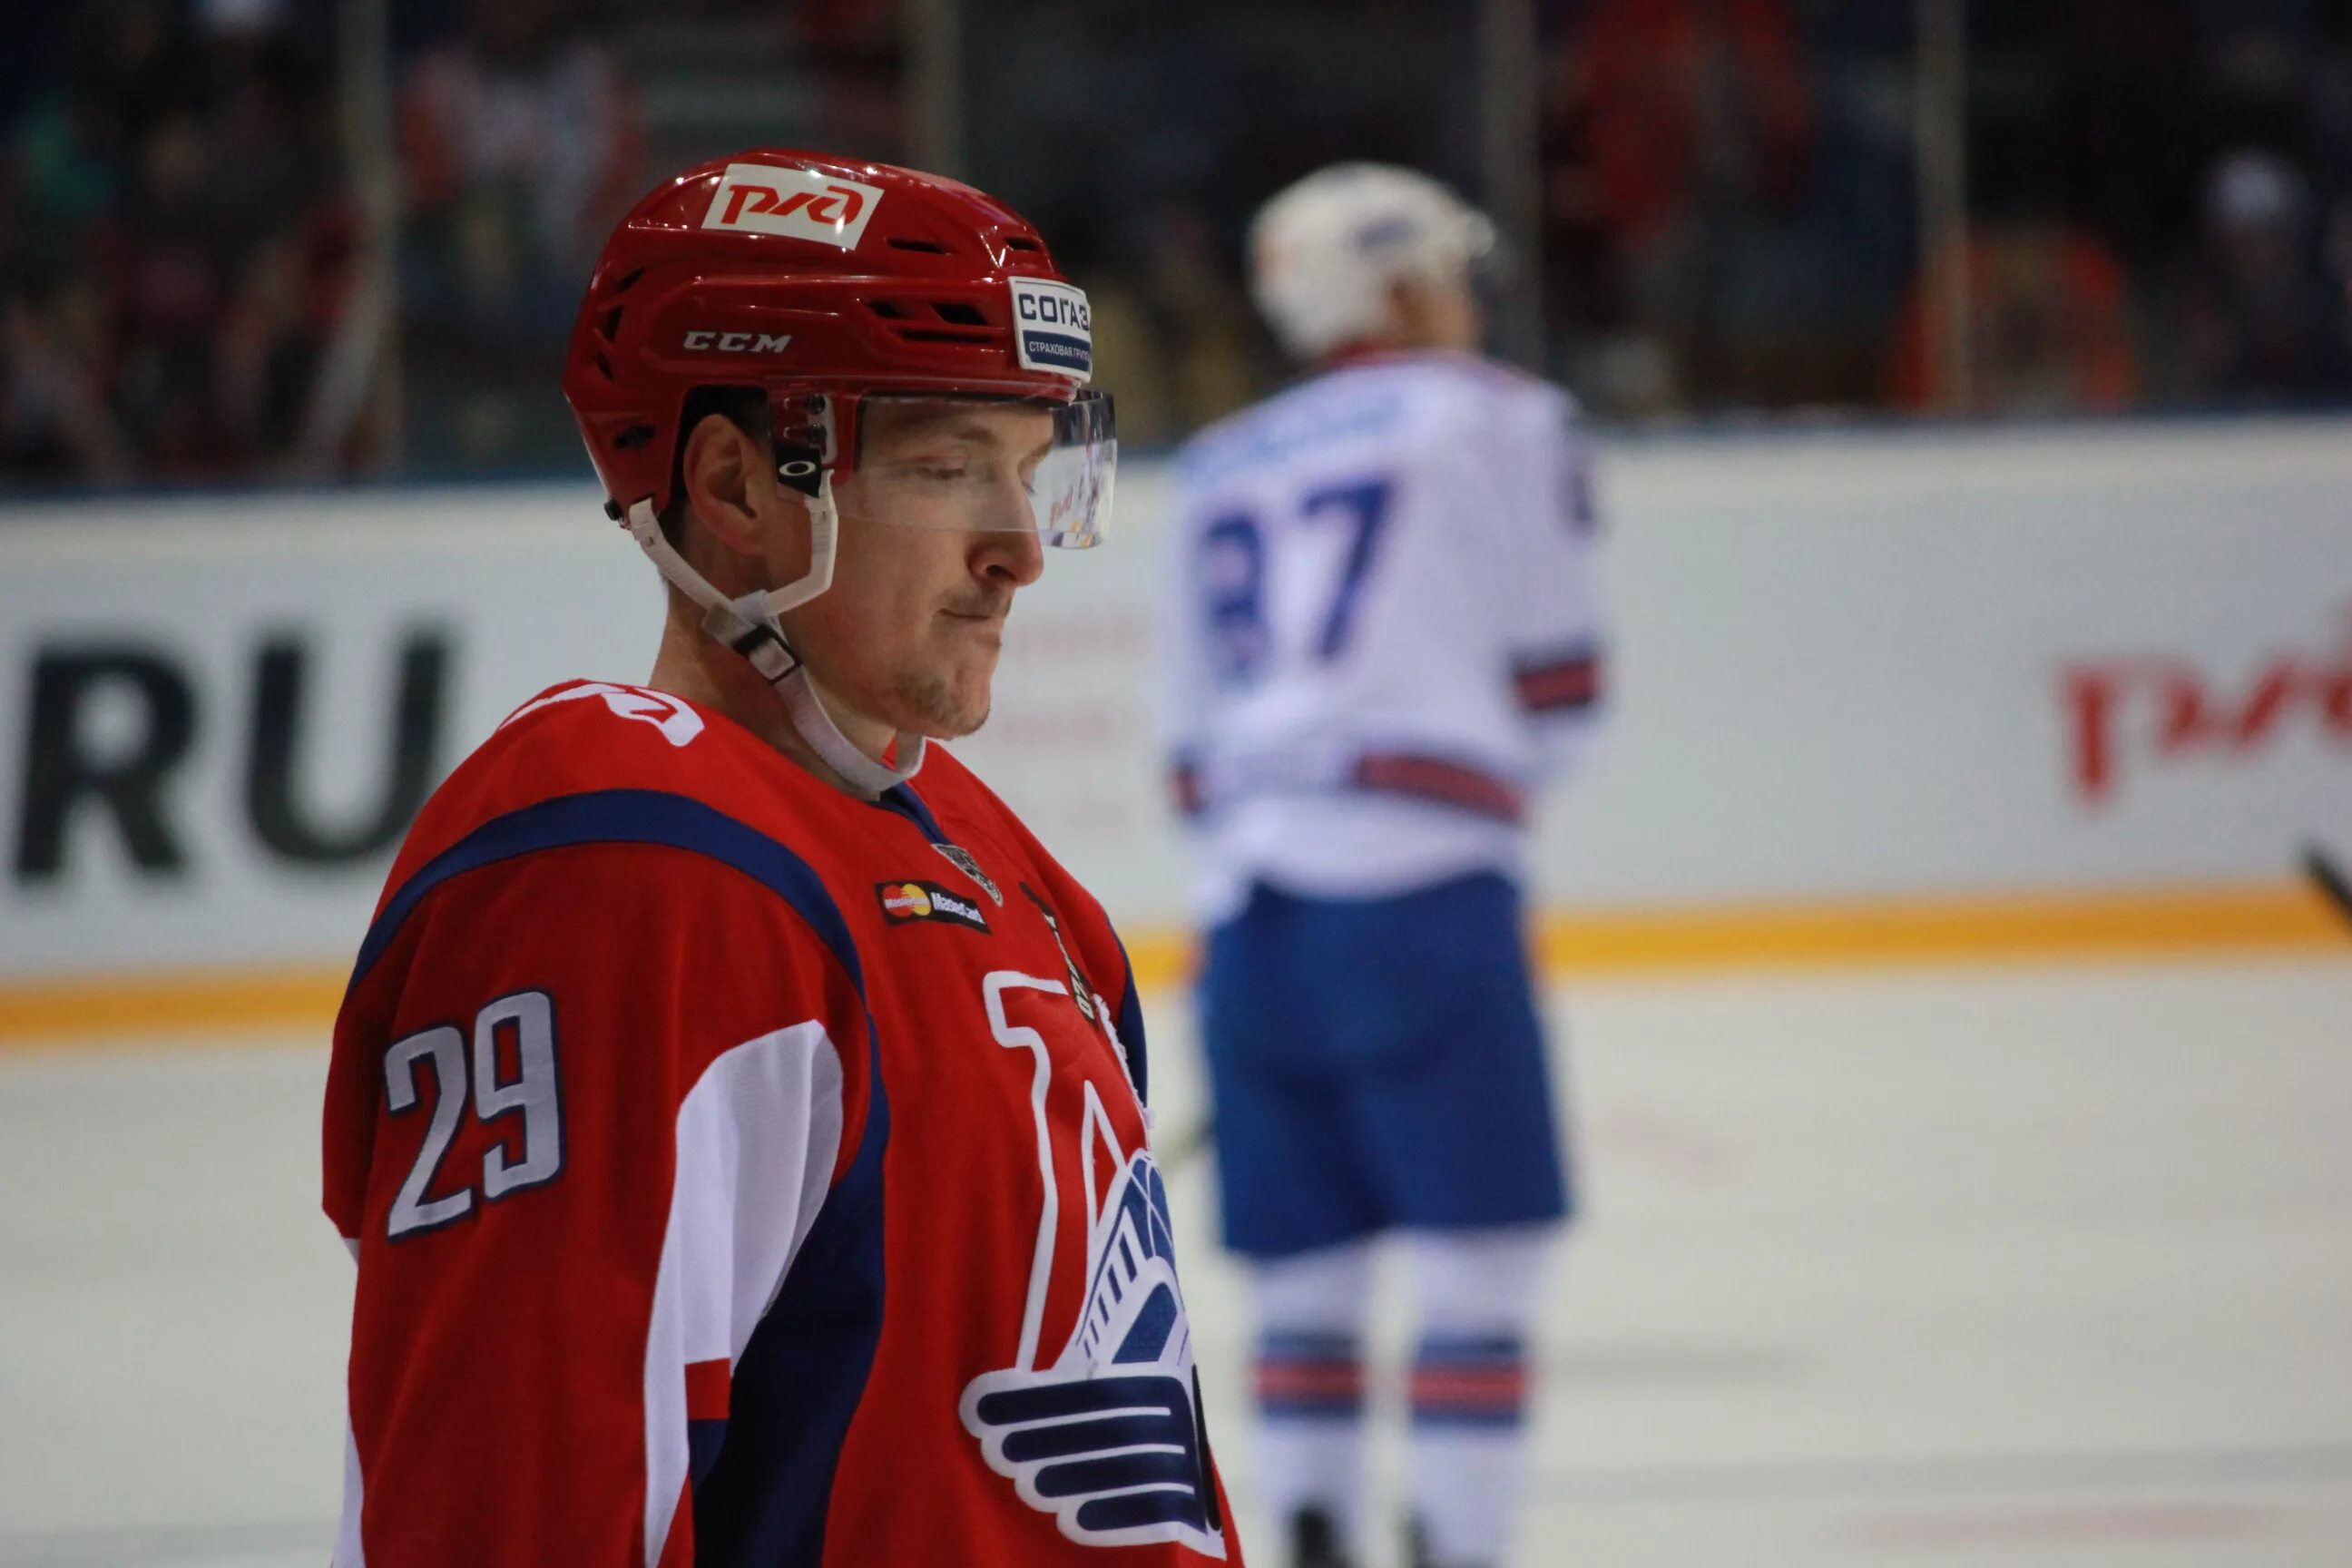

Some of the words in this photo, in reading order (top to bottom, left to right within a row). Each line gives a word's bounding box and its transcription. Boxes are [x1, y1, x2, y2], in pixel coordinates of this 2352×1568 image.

[683, 331, 792, 353] CCM
[1018, 293, 1090, 332] СОГАЗ
[14, 631, 452, 880] RU
[384, 989, 563, 1240] 29
